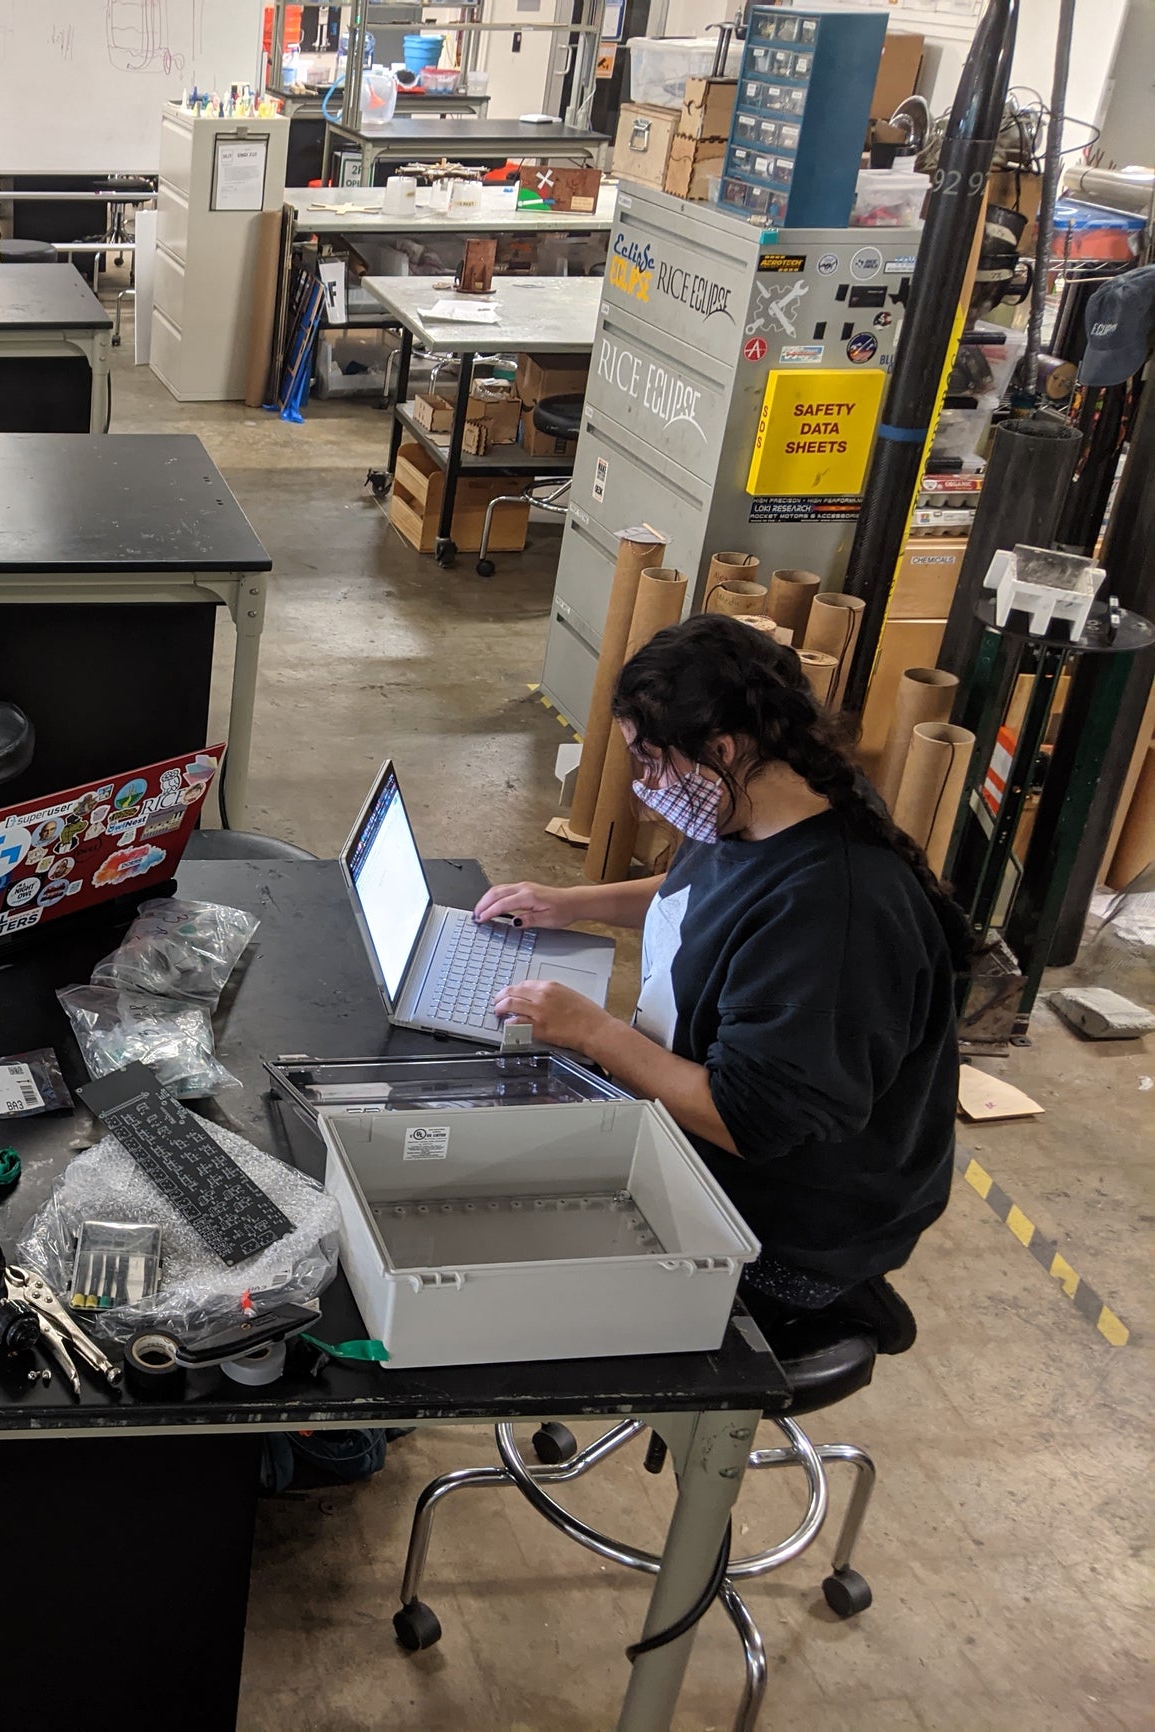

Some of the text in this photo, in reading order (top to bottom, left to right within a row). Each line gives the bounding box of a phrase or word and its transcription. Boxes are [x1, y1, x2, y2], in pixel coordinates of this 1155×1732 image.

[656, 261, 733, 316] RICE ECLIPSE
[598, 338, 702, 421] RICE ECLIPSE
[794, 403, 856, 416] SAFETY
[800, 422, 840, 435] DATA
[785, 441, 847, 454] SHEETS
[912, 556, 955, 564] CHEMICALS
[16, 803, 74, 826] superuser
[14, 883, 35, 895] NIGHT
[17, 890, 33, 900] OWL
[6, 1100, 24, 1111] BA3
